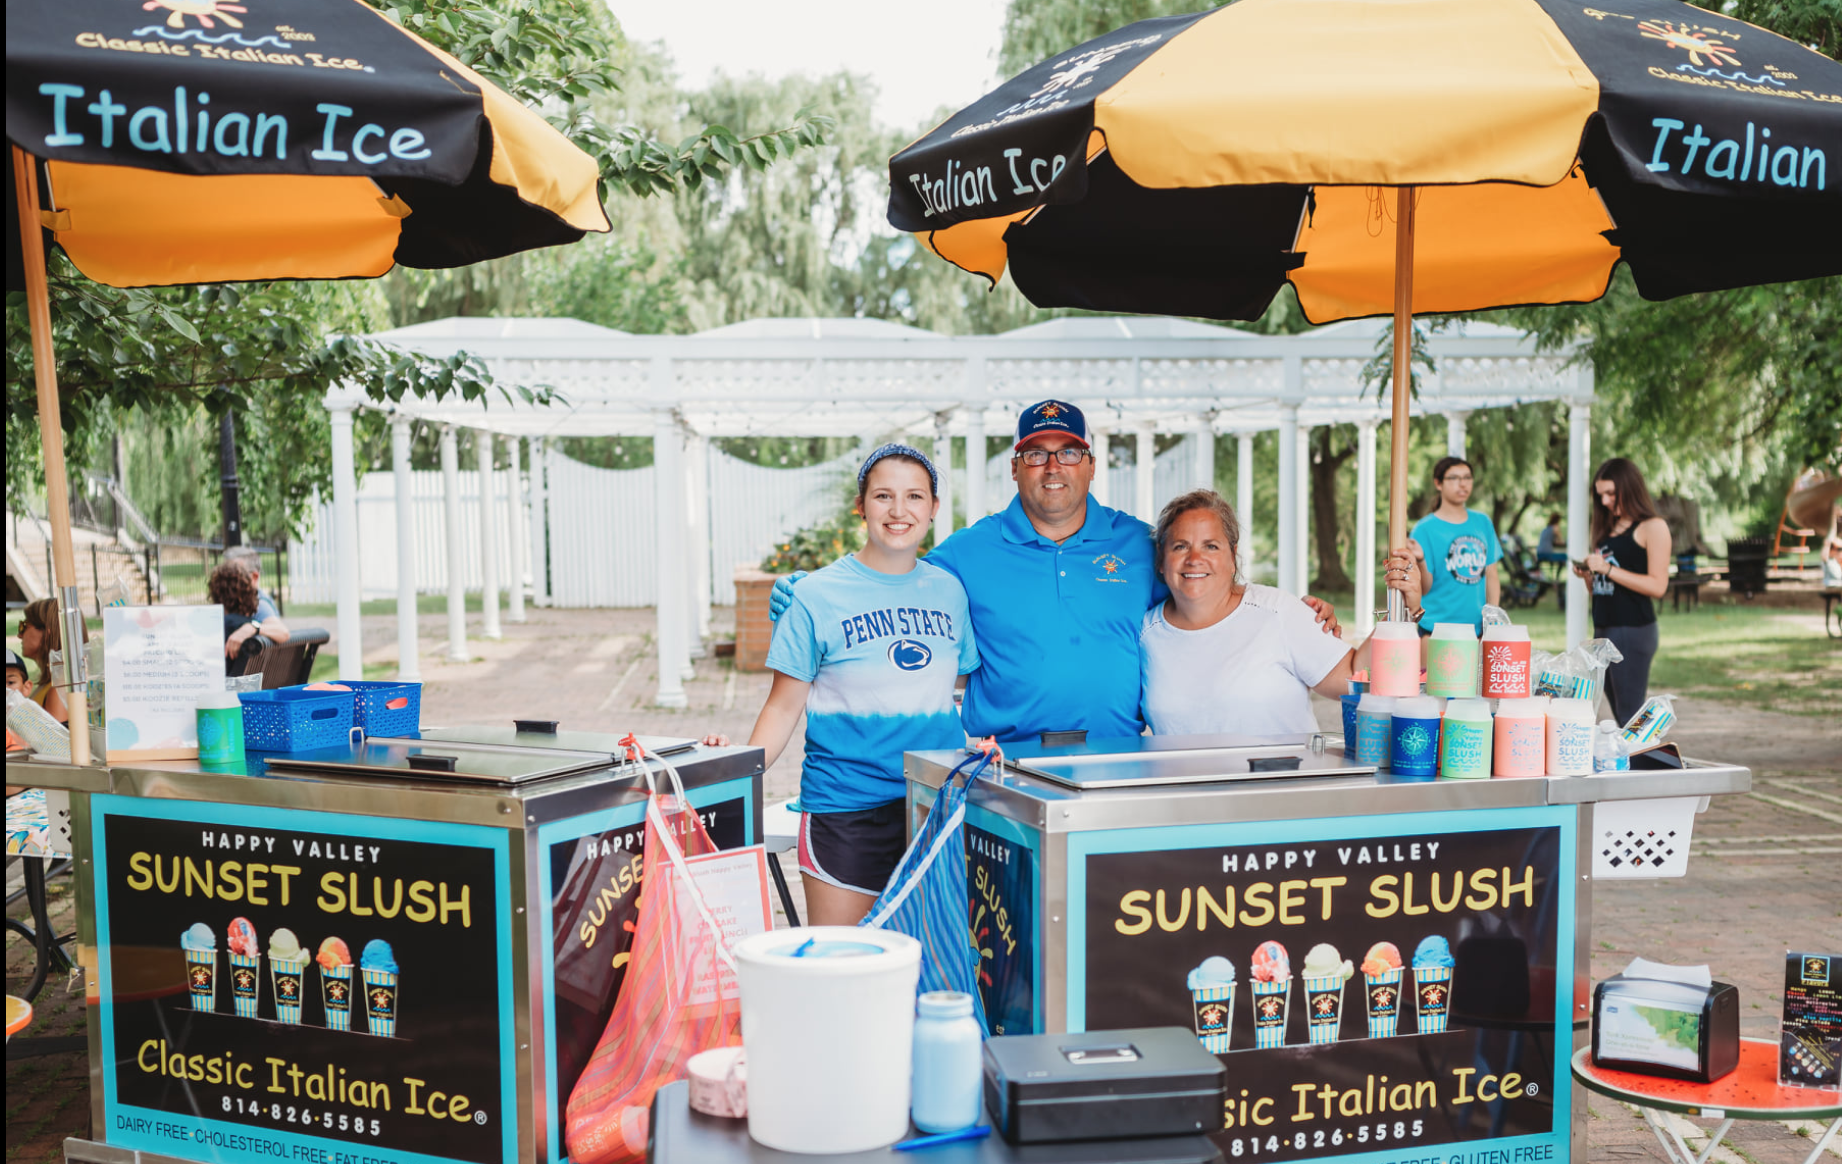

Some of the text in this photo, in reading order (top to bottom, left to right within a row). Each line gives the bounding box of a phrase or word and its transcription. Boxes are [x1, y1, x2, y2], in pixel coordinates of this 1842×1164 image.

[75, 32, 191, 57] Classic
[193, 44, 305, 67] Italian
[38, 83, 432, 164] Italian Ice
[1645, 117, 1826, 191] Italian
[908, 159, 998, 219] Italian
[1444, 551, 1487, 571] WORLD
[841, 606, 957, 650] PENN STATE
[1490, 673, 1526, 683] SLUSH
[1448, 748, 1483, 759] SLUSH
[1558, 747, 1590, 756] SLUSH
[202, 830, 382, 864] HAPPY VALLEY
[585, 811, 718, 861] HAPPY ALLEY
[969, 833, 1011, 866] VALLEY
[1222, 840, 1442, 874] HAPPY VALLEY
[127, 851, 473, 929] SUNSET SLUSH
[579, 853, 644, 949] SUNSE
[974, 865, 1017, 956] SLUSH
[1114, 865, 1535, 937] SUNSET SLUSH
[136, 1037, 254, 1090] Classic
[265, 1056, 392, 1112] Italian
[1290, 1074, 1438, 1124] Italian
[116, 1114, 153, 1135] DAIRY
[156, 1121, 189, 1142] FREE
[195, 1128, 290, 1160] CHOLESTEROL
[1450, 1149, 1510, 1164] GLUTEN
[1514, 1144, 1554, 1163] FREE
